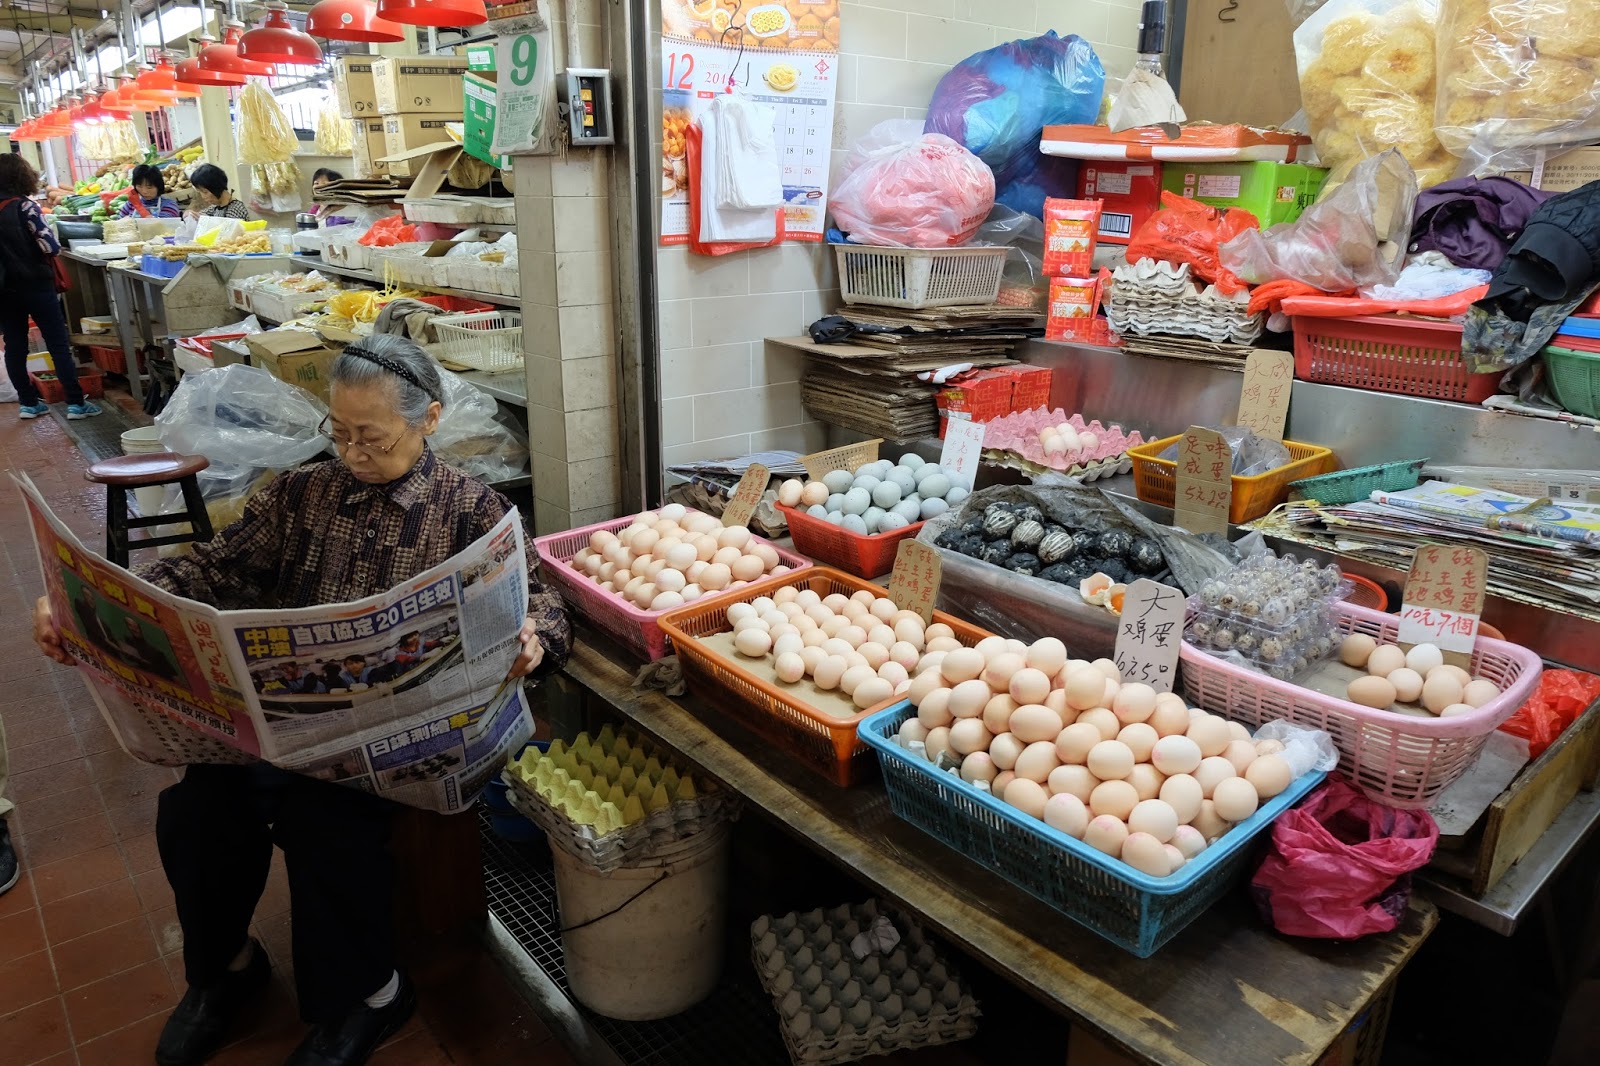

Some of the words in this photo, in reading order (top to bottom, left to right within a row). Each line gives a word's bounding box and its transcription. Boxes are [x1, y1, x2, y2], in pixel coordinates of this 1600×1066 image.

[510, 34, 537, 86] 9
[666, 52, 695, 90] 12
[705, 71, 730, 84] 201
[807, 128, 815, 136] 12
[806, 148, 814, 156] 19
[1036, 371, 1051, 386] LEE
[1184, 435, 1229, 459] 足味
[292, 580, 453, 646] 自貿協定20日生效
[1139, 587, 1176, 618] 大
